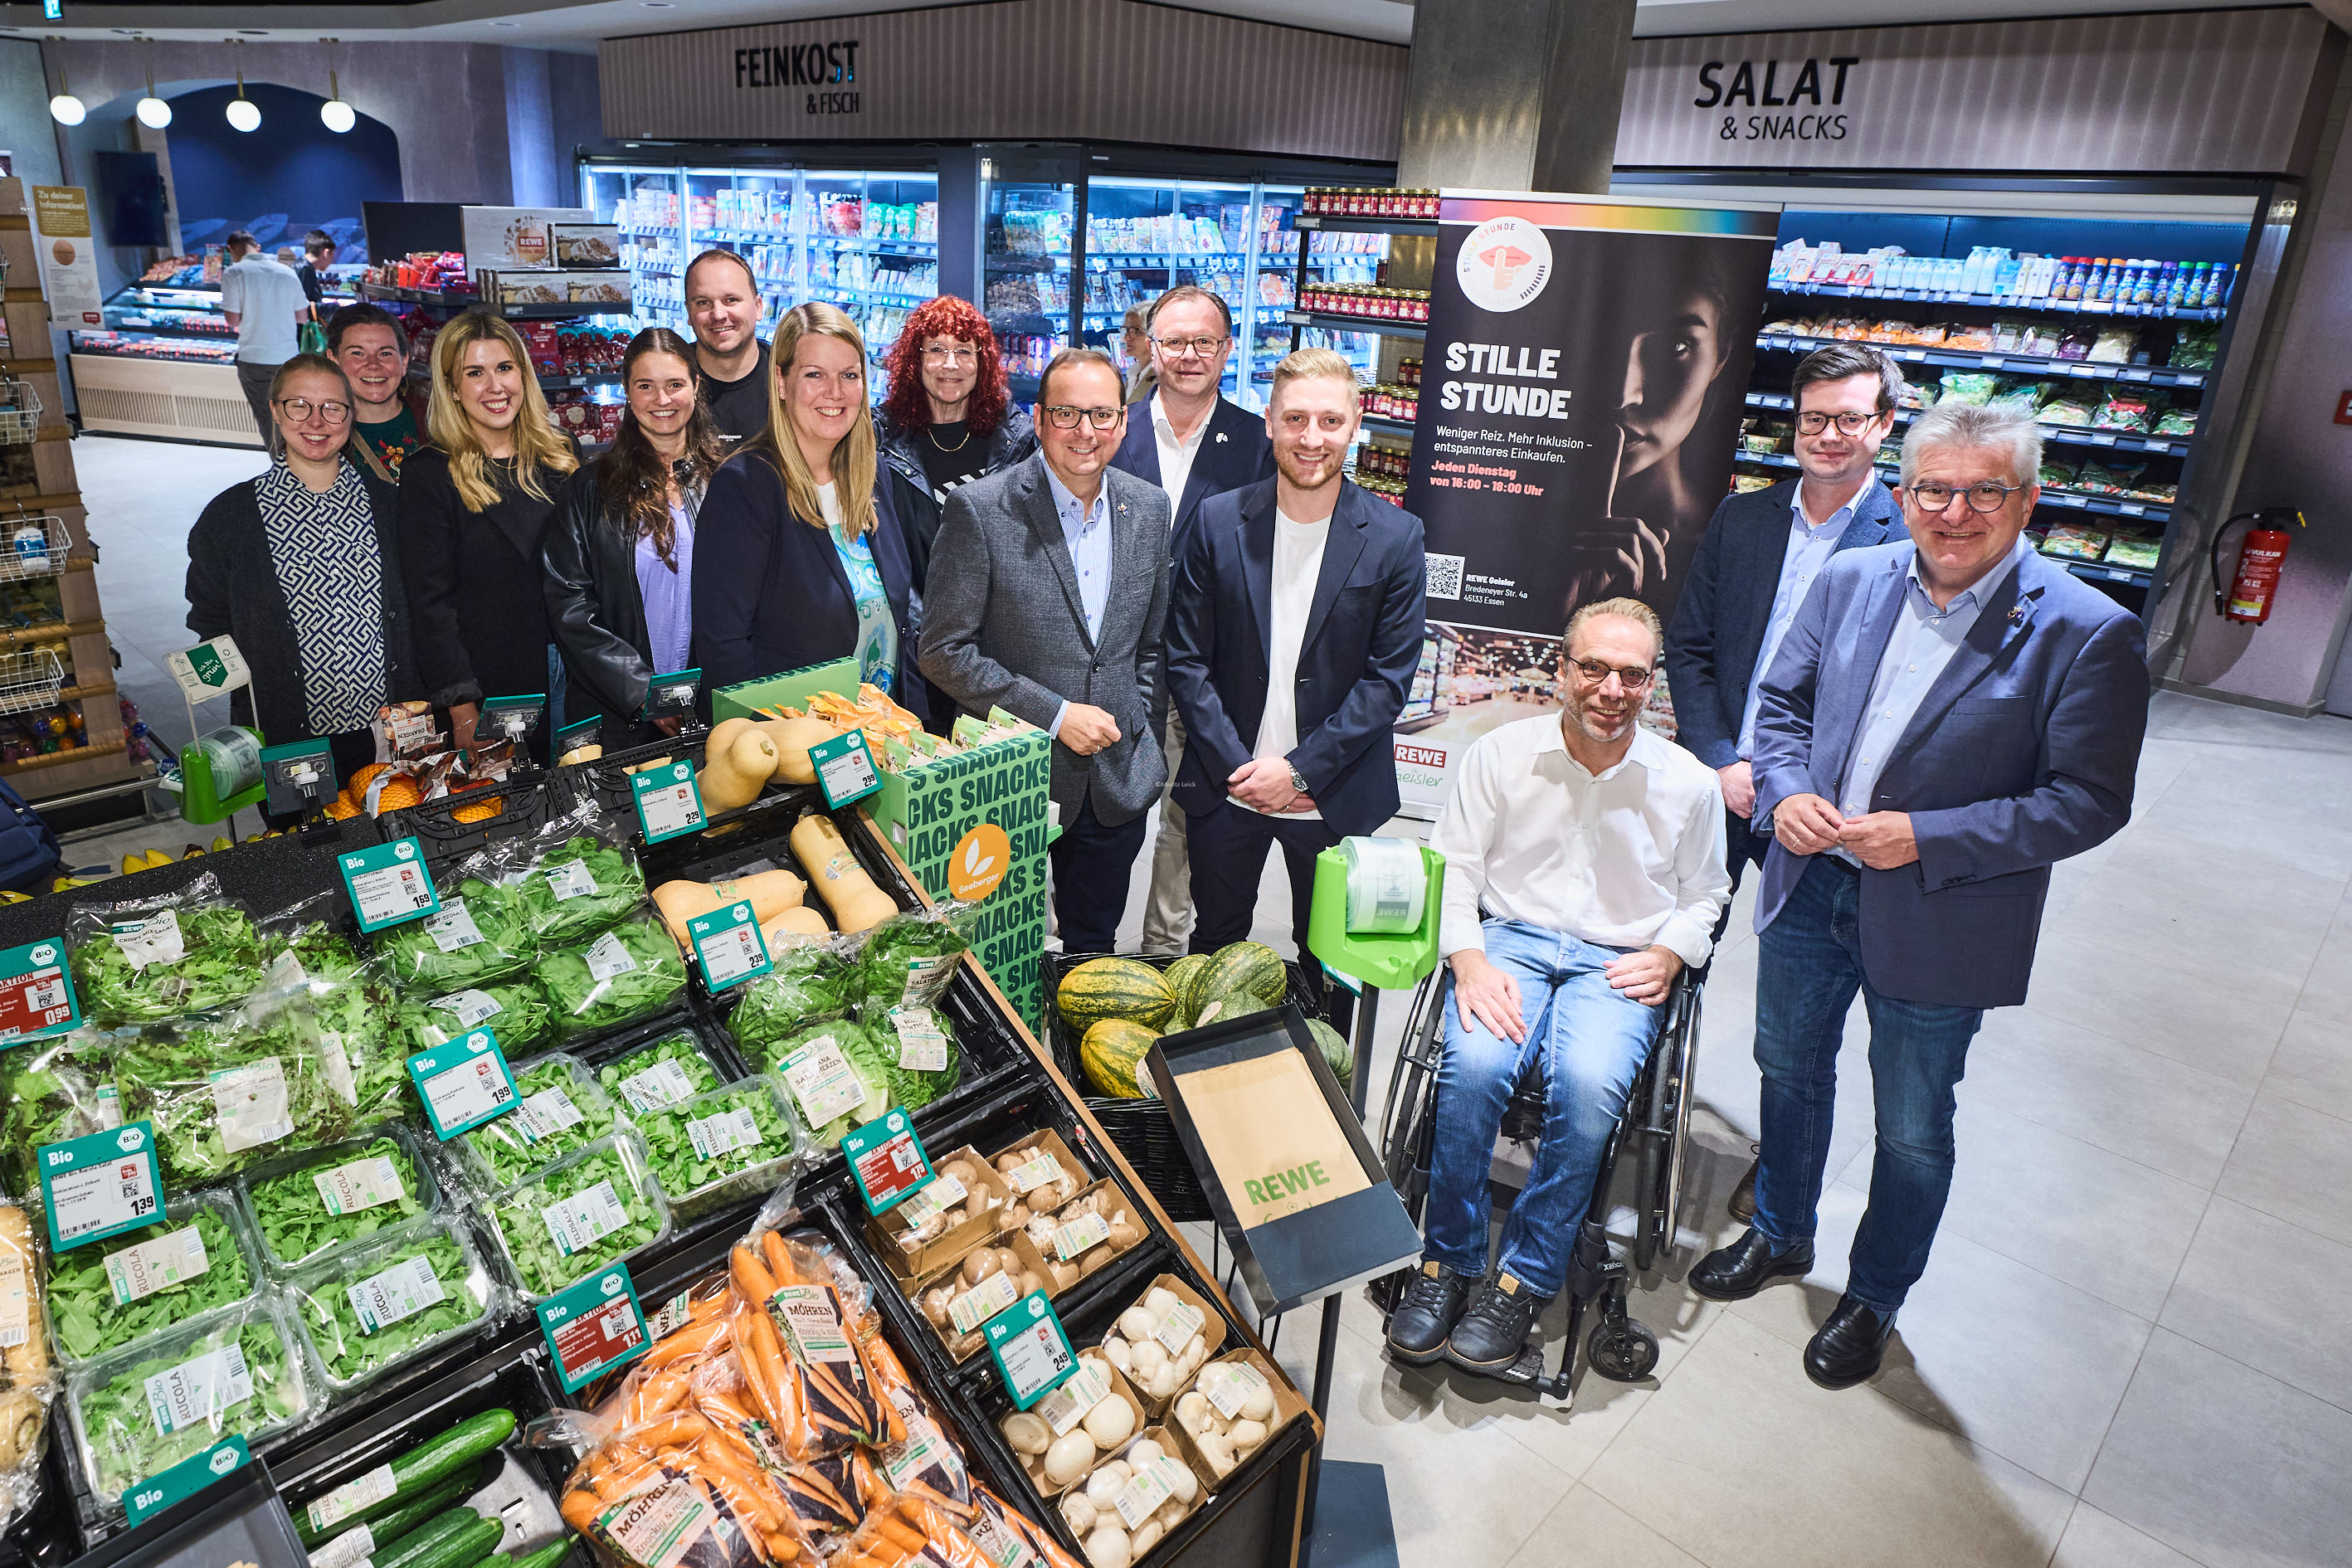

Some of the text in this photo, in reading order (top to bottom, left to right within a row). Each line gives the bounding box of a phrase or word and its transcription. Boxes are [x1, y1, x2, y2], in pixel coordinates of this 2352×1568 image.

[735, 41, 859, 88] FEINKOST
[1694, 57, 1859, 108] SALAT
[806, 92, 859, 114] & FISCH
[1721, 114, 1848, 140] & SNACKS
[37, 190, 73, 200] Zu deiner
[40, 201, 85, 210] Information!
[1463, 223, 1516, 273] STILLE STUNDE
[1445, 342, 1561, 379] STILLE
[1440, 380, 1572, 420] STUNDE
[1436, 425, 1478, 442] Weniger
[1481, 430, 1505, 442] Reiz.
[1508, 431, 1534, 444] Mehr
[1536, 434, 1584, 449] Inklusion
[1434, 442, 1566, 464] entspannteres Einkaufen.
[1431, 460, 1517, 480] Jeden Dienstag
[1429, 476, 1449, 487] von
[1452, 477, 1481, 489] 16:00
[1492, 481, 1522, 494] 18:00
[1524, 484, 1544, 496] Uhr
[2251, 548, 2281, 558] VULKAN
[1466, 574, 1515, 587] REWE Geisler
[1463, 594, 1505, 606] 45133 Essen
[1465, 584, 1503, 597] Bredeneyer
[1505, 589, 1517, 598] Str.
[202, 660, 222, 682] grün!
[398, 728, 425, 739] ORANGEN
[814, 749, 827, 758] Bio
[927, 737, 1030, 784] SNACKS
[1395, 746, 1444, 766] REWE
[636, 777, 651, 787] Bio
[862, 773, 875, 787] 2.99
[960, 755, 1049, 811] SNACKS
[685, 811, 699, 825] 2.29
[345, 858, 365, 869] Bio
[958, 873, 1000, 894] Seeberger
[413, 894, 430, 908] 1.69
[440, 900, 460, 912] Bio
[119, 935, 142, 943] CRISPY
[154, 924, 173, 935] SALAT
[694, 922, 710, 933] Bio
[749, 953, 763, 968] 2.39
[918, 961, 934, 969] REWE
[45, 1006, 71, 1025] 0.99
[324, 1049, 341, 1059] ALAT
[249, 1061, 275, 1074] Bio
[415, 1058, 436, 1073] Bio
[491, 1086, 511, 1104] 1.99
[847, 1137, 864, 1152] Bio
[871, 1138, 894, 1157] AKTION
[47, 1150, 74, 1166] Bio
[321, 1176, 334, 1195] Bio
[334, 1170, 355, 1209] RUCOLA
[1244, 1160, 1331, 1205] REWE
[130, 1195, 154, 1216] 1.39
[561, 1205, 582, 1245] FELDSALAT
[111, 1257, 128, 1297] REWE Bio
[129, 1249, 149, 1293] RUCOLA
[369, 1280, 392, 1321] RUCOLA
[801, 1288, 820, 1301] Bio
[356, 1288, 374, 1326] REWE Bio
[545, 1306, 567, 1322] Bio
[575, 1303, 606, 1325] AKTION
[788, 1303, 834, 1317] MÖHREN
[622, 1328, 642, 1348] 1.11
[990, 1324, 1007, 1340] Bio
[1053, 1351, 1069, 1372] 2.49
[153, 1380, 170, 1426] REWE Bio
[169, 1371, 192, 1421] RUCOLA
[134, 1489, 163, 1511] Bio
[616, 1480, 672, 1537] MÖHREN
[634, 1493, 694, 1556] Knackig & mild.
